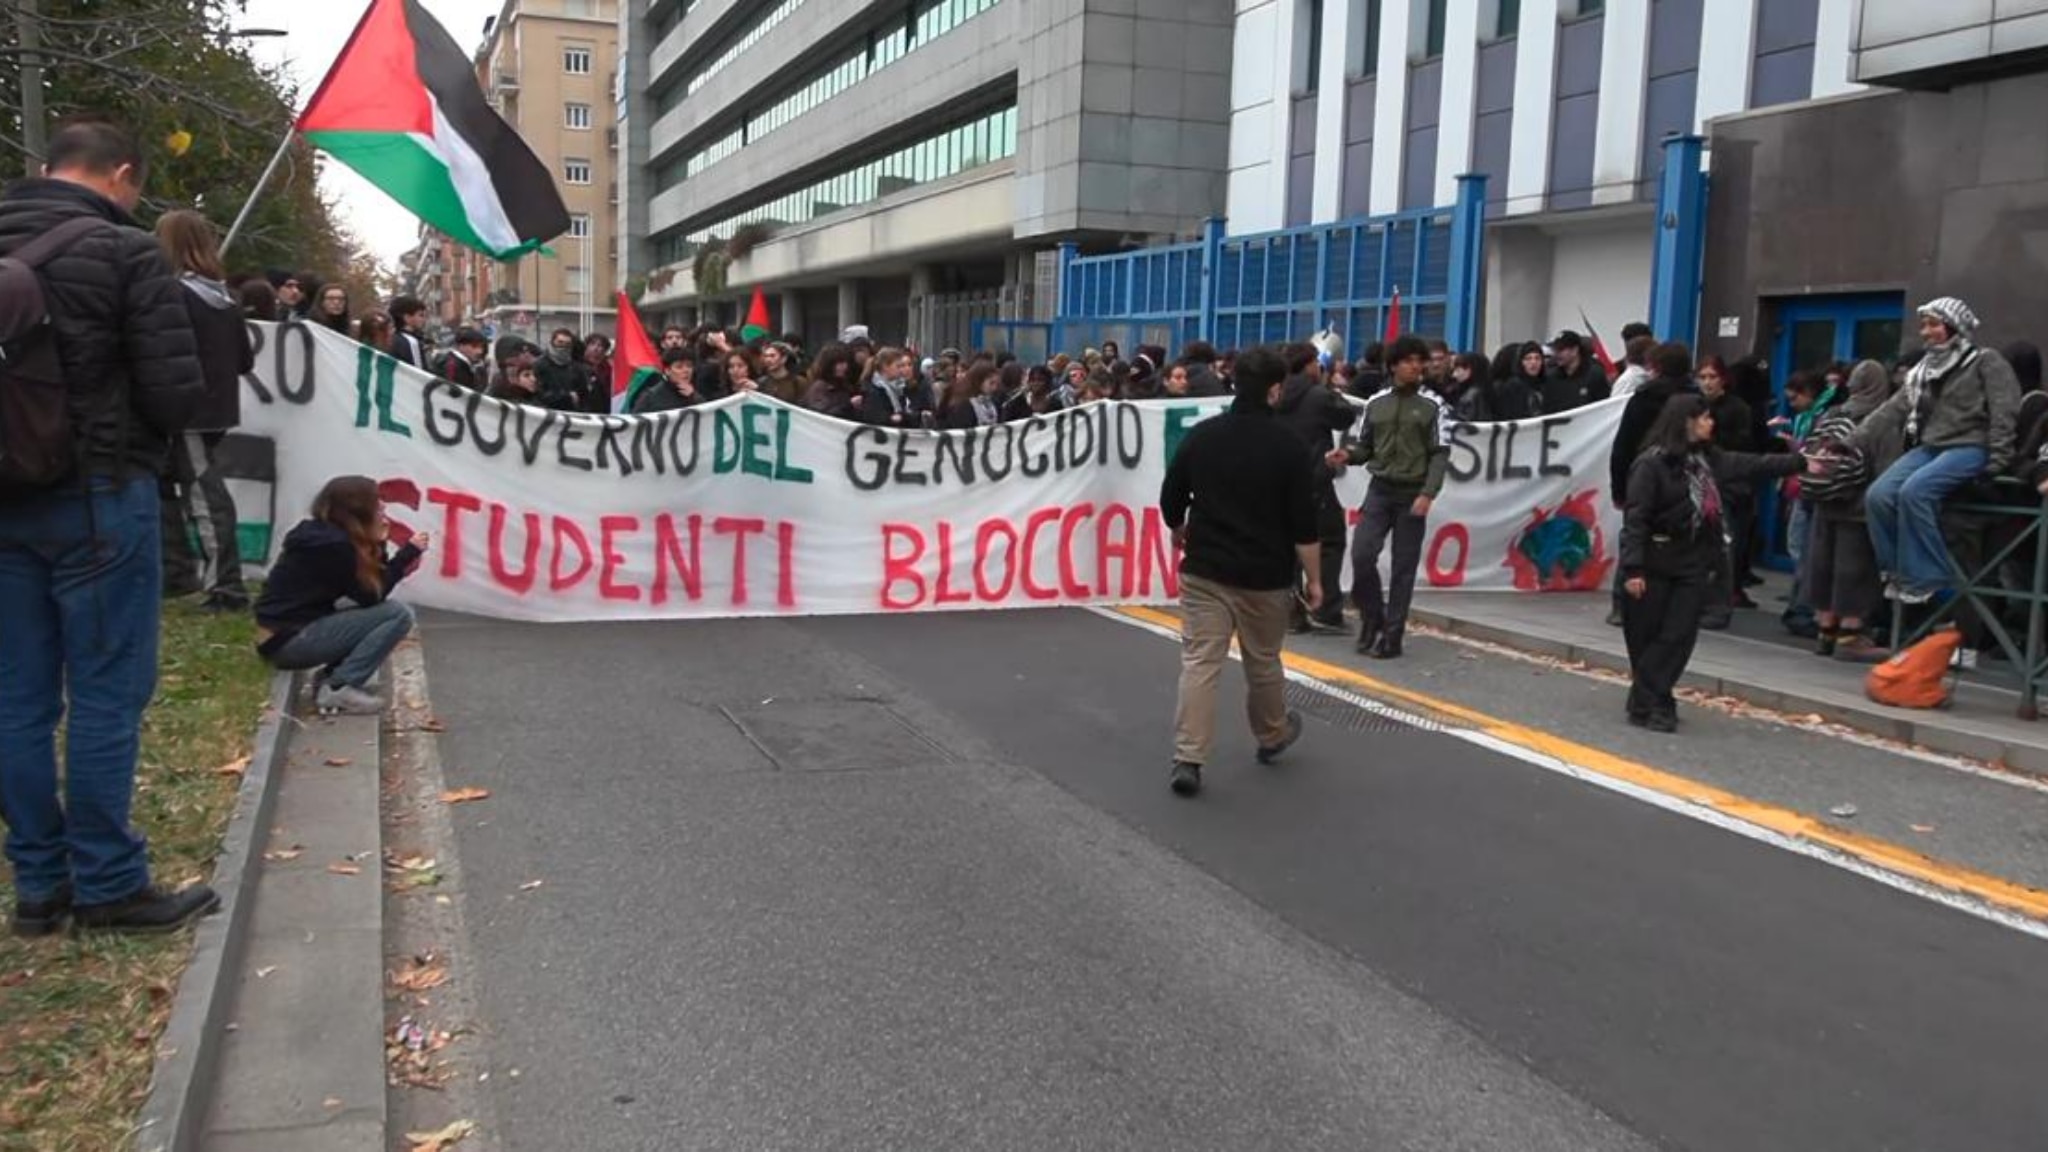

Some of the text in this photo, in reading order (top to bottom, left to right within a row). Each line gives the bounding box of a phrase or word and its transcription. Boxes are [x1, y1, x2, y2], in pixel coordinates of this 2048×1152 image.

[243, 322, 315, 404] RO
[355, 346, 411, 437] IL
[423, 379, 700, 475] GOVERNO
[712, 405, 813, 484] DEL
[846, 403, 1143, 491] GENOCIDIO
[1447, 419, 1571, 481] SILE
[881, 503, 1181, 608] BLOCCAN
